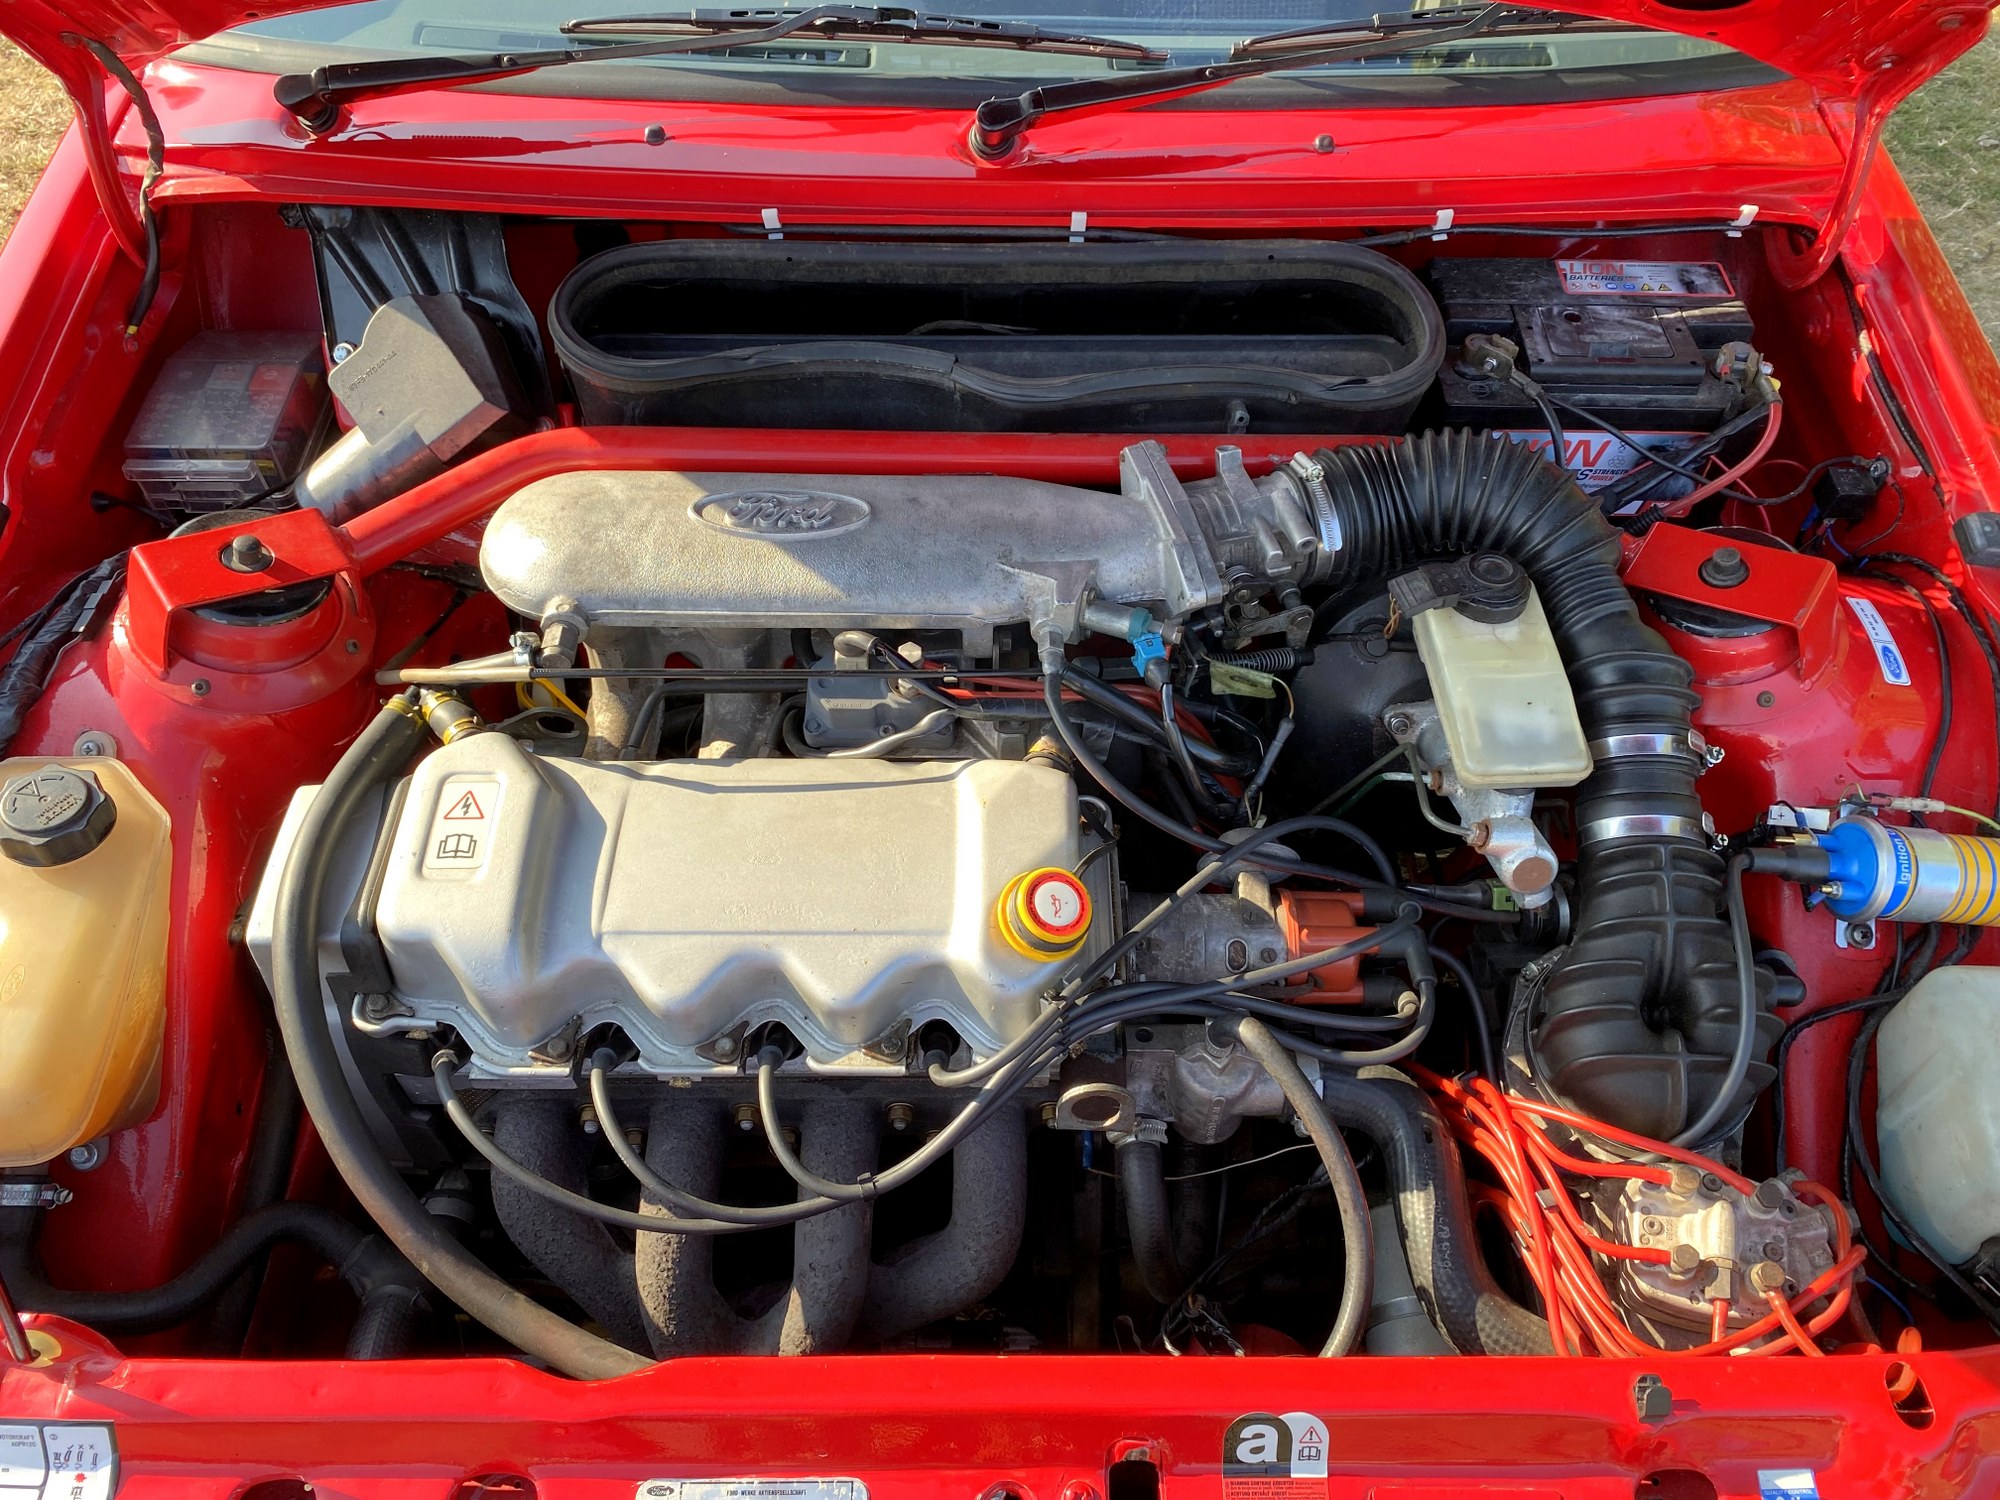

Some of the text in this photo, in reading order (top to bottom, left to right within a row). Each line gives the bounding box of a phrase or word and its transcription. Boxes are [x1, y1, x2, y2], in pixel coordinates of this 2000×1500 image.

[1569, 262, 1625, 276] LION
[723, 494, 838, 529] Ford
[1894, 838, 1912, 885] Ignition
[1236, 1424, 1279, 1464] a
